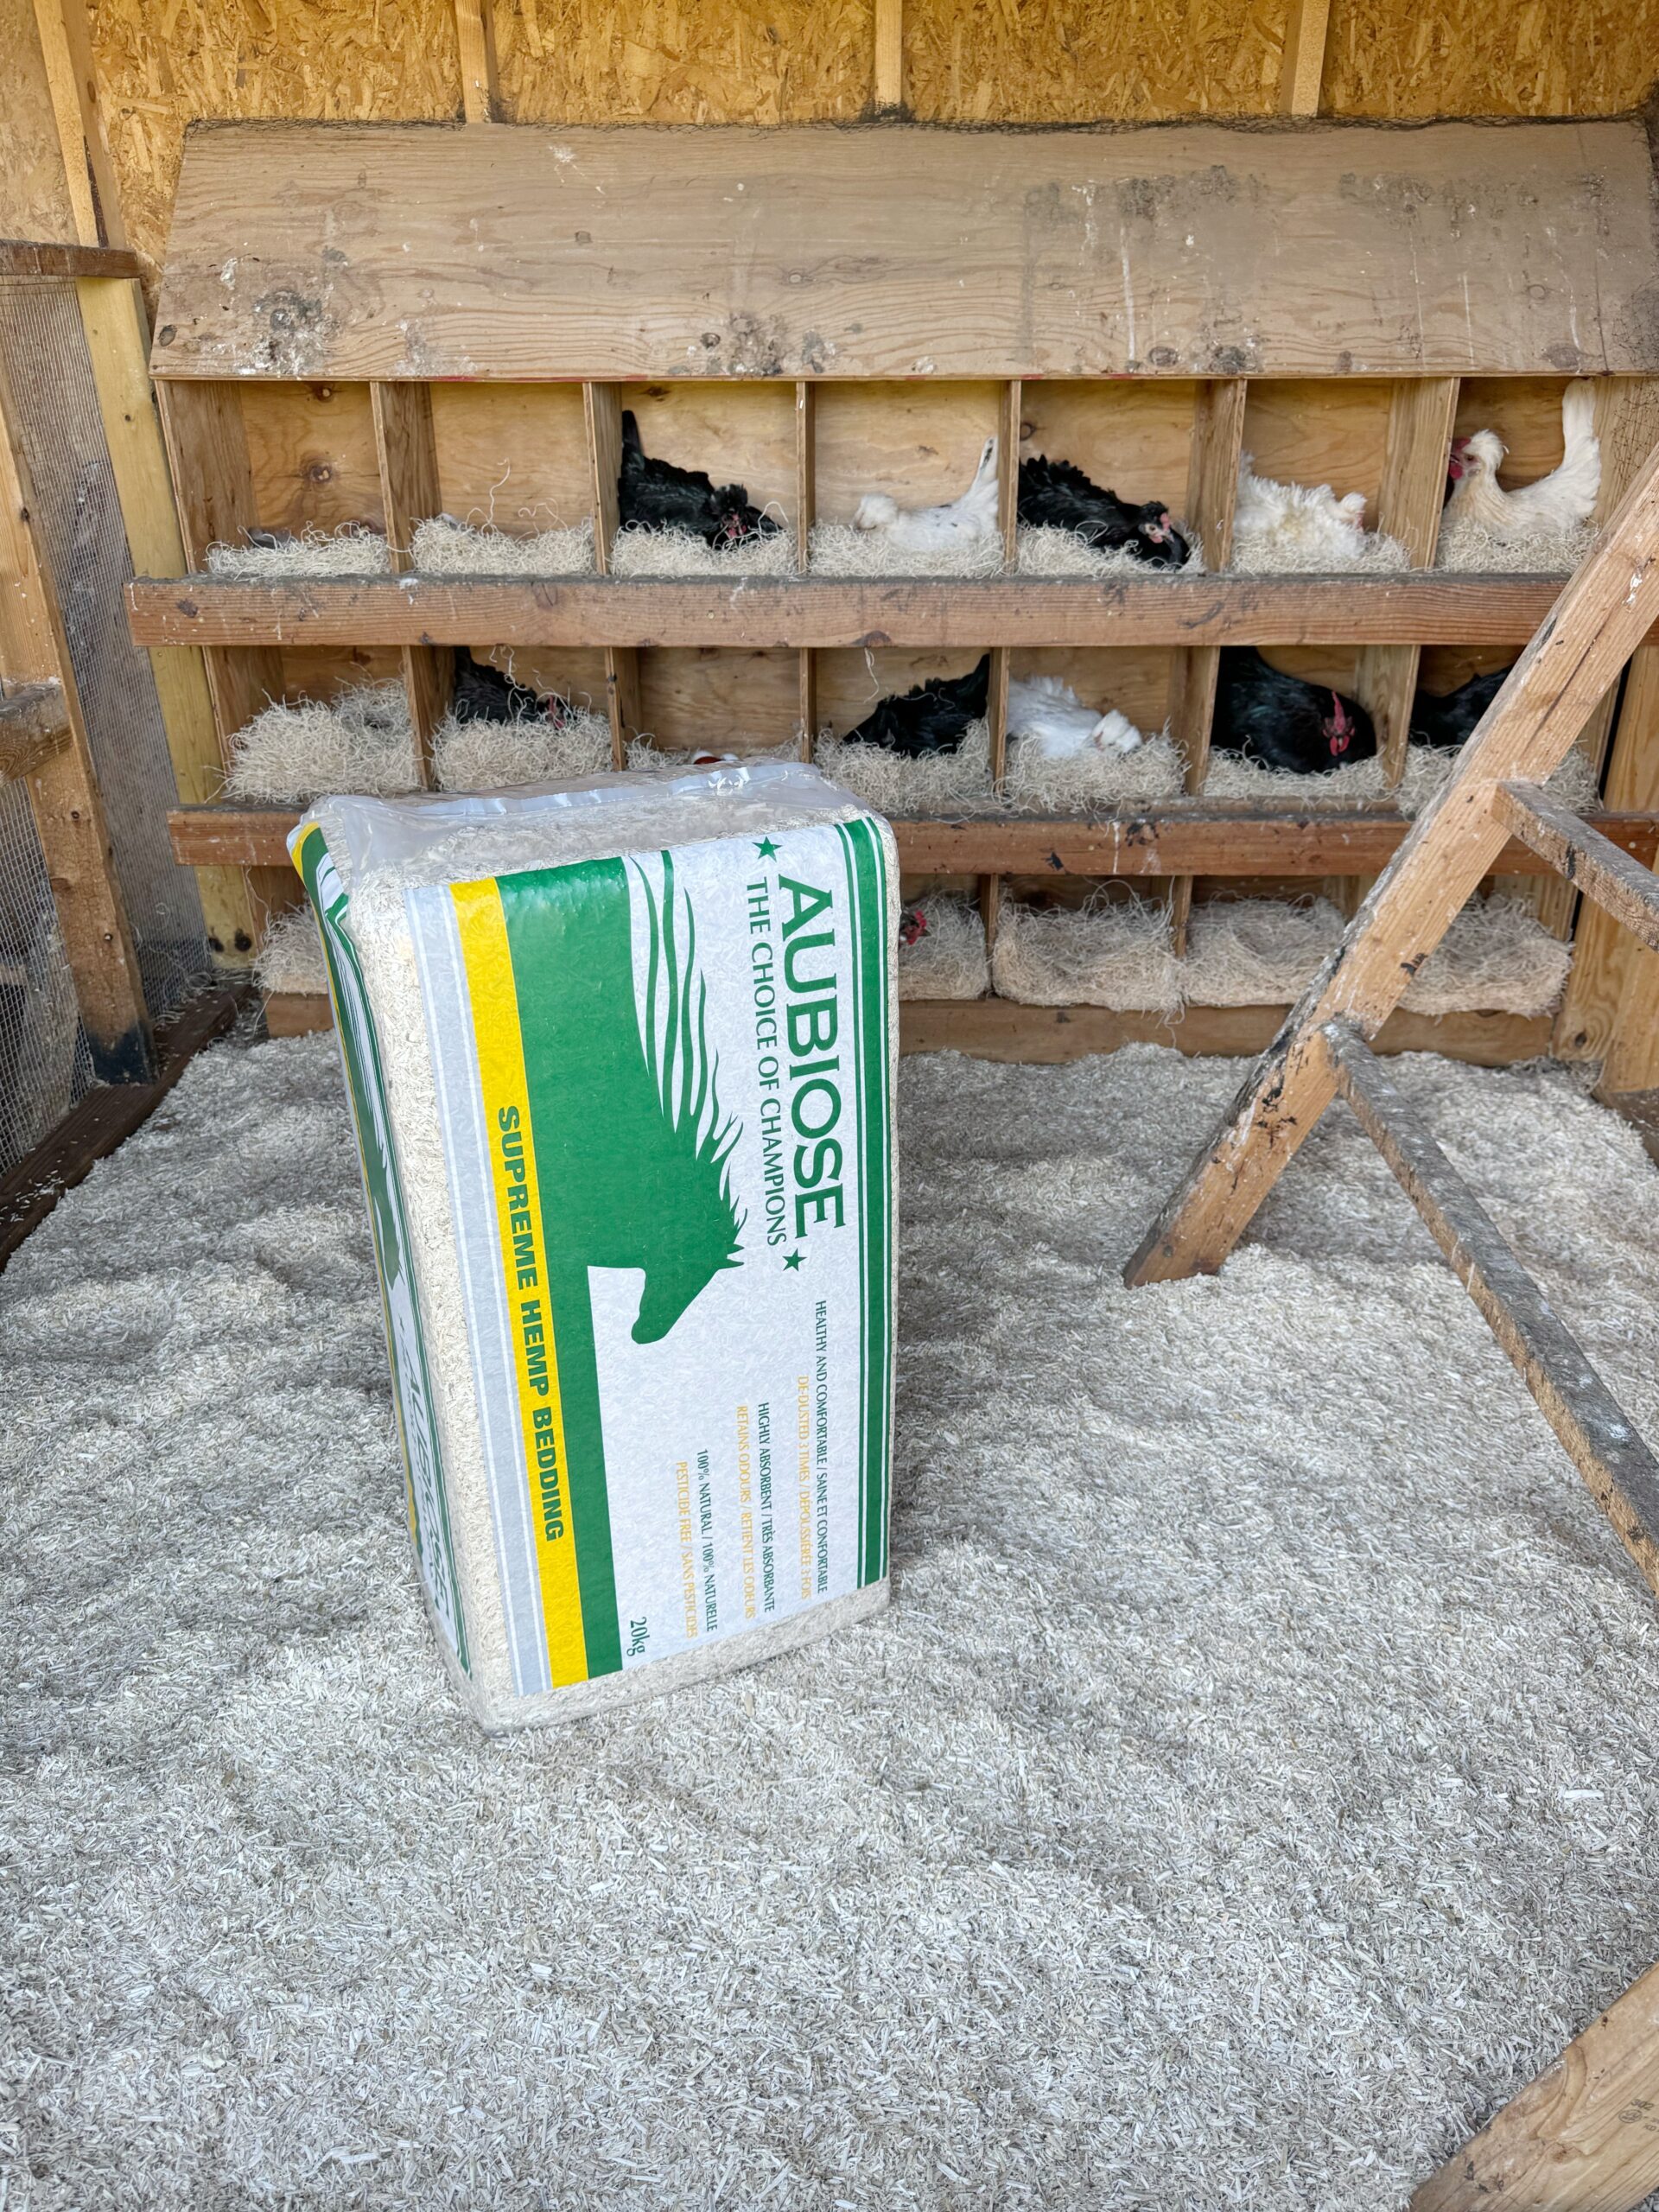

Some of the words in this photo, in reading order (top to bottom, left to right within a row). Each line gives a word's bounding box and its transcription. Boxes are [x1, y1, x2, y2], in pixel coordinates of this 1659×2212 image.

[747, 876, 771, 934] THE
[752, 942, 778, 1050] CHOICE
[758, 1056, 779, 1090] OF
[778, 874, 846, 1238] AUBIOSE
[760, 1098, 786, 1246] CHAMPIONS
[498, 1105, 537, 1290] SUPREME
[521, 1300, 549, 1396] HEMP
[816, 1300, 827, 1351] HEALTHY
[817, 1356, 827, 1382] AND
[737, 1406, 749, 1451] RETAINS
[758, 1402, 771, 1444] HIGHLY
[798, 1376, 810, 1440] DE-DUSTED
[817, 1383, 828, 1465] COMFORTABLE
[405, 1348, 450, 1618] AUBIOSE
[532, 1406, 563, 1541] BEDDING
[677, 1461, 690, 1516] PESTICIDE
[696, 1449, 710, 1480] 100%
[739, 1453, 751, 1503] ODOURS
[760, 1448, 772, 1510] ABSORBENT
[799, 1451, 810, 1481] TIMES
[817, 1472, 828, 1504] SAINE
[679, 1519, 692, 1541] FREE
[698, 1483, 712, 1535] NATURAL
[741, 1512, 753, 1554] RETIENT
[762, 1517, 776, 1543] TRÈS
[817, 1505, 828, 1516] ET
[681, 1551, 695, 1580] SANS
[702, 1541, 715, 1573] 100%
[742, 1557, 753, 1573] LES
[763, 1546, 775, 1612] ABSORBANTE
[817, 1519, 828, 1593] CONFORTABLE
[683, 1582, 697, 1638] PESTICIDES
[704, 1573, 717, 1631] NATURELLE
[744, 1576, 755, 1619] ODEURS
[801, 1578, 811, 1599] FOIS
[626, 1617, 650, 1656] 20kg
